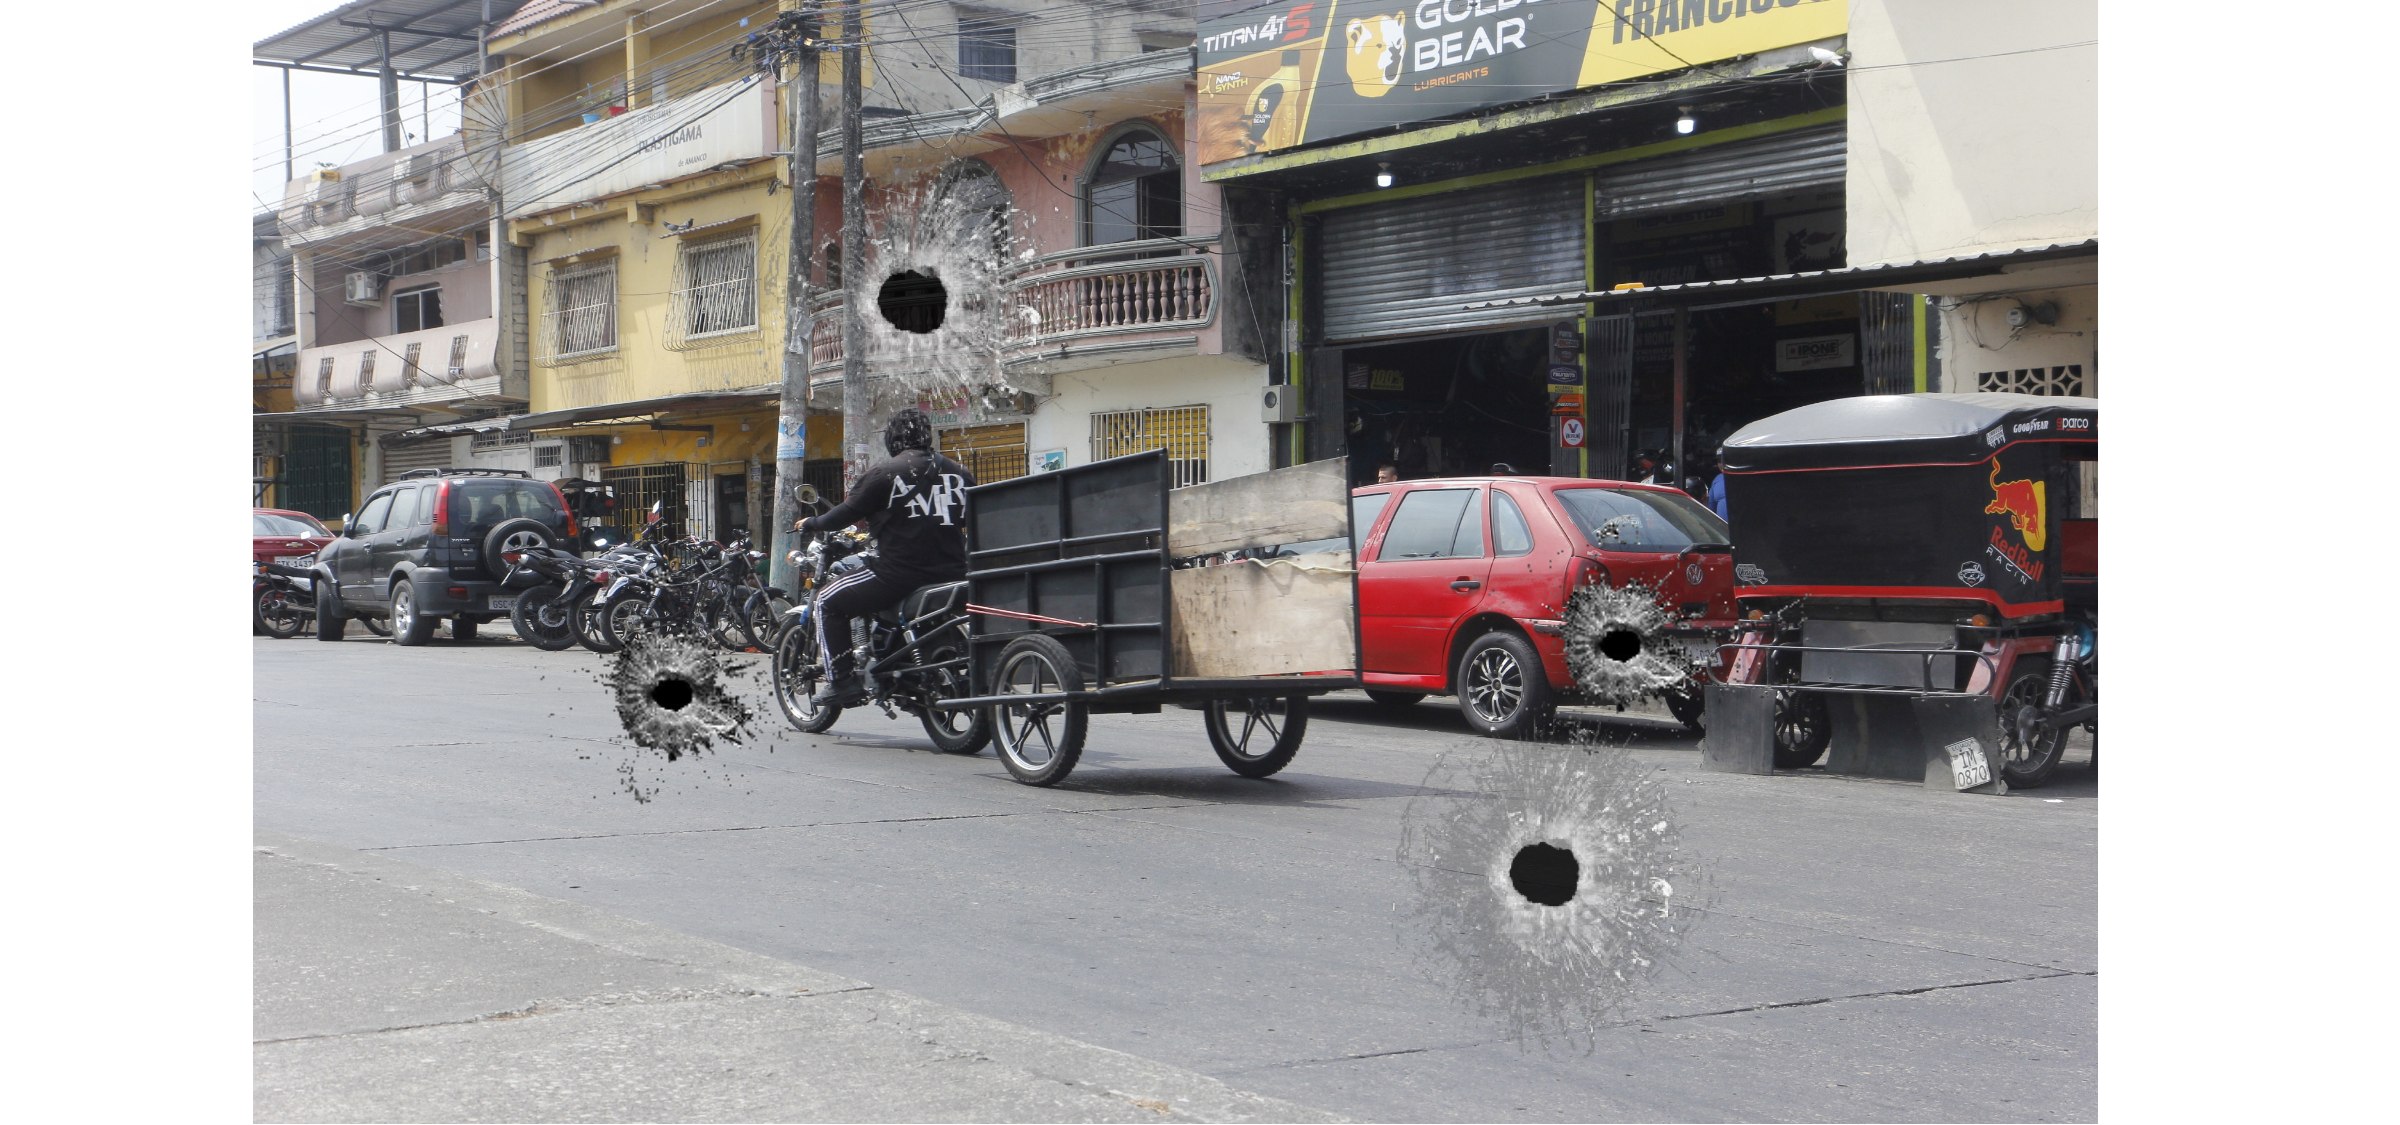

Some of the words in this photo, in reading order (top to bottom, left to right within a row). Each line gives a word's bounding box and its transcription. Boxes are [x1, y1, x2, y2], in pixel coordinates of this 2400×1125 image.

[1203, 24, 1258, 53] TITAN
[1414, 17, 1527, 72] BEAR
[1215, 71, 1241, 85] NANO
[1215, 77, 1249, 93] SYNTH
[1414, 66, 1489, 92] LUBRICANTS
[638, 124, 703, 155] PLASTIGAMA
[678, 160, 685, 168] de
[685, 153, 708, 165] AMANCO
[2013, 418, 2049, 434] GOODYEAR
